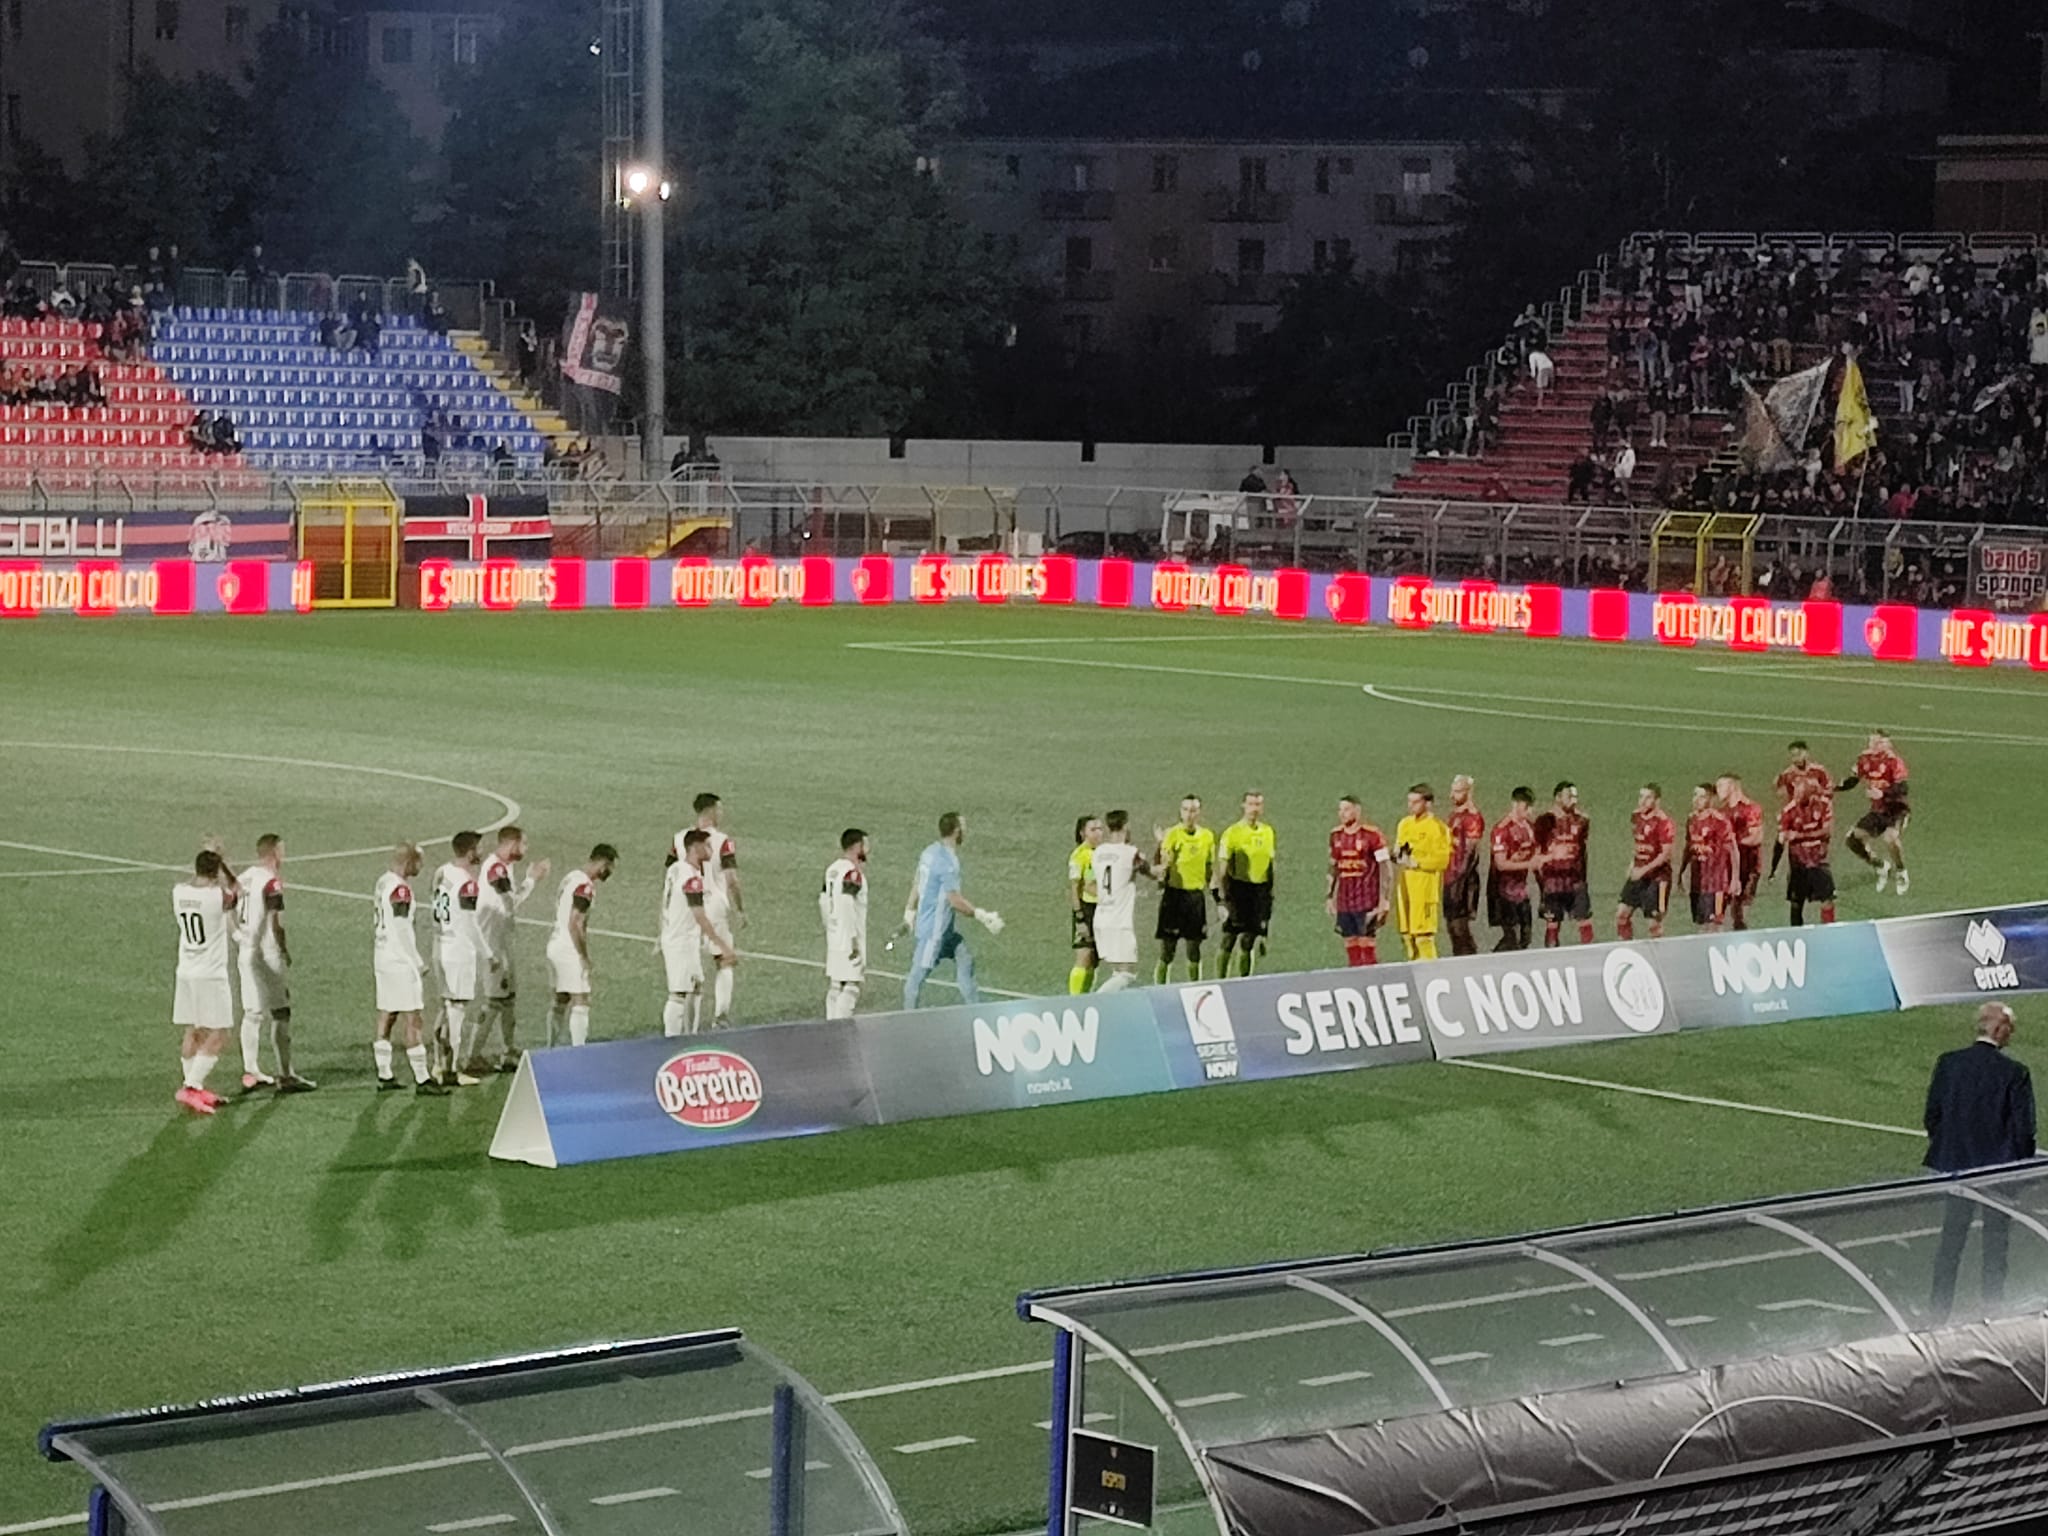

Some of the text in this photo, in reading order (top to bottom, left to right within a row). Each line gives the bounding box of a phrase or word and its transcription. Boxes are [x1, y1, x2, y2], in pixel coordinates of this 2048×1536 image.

[1982, 546, 2040, 572] banda
[0, 570, 158, 608] OTENZA CALCIO
[440, 567, 487, 604] SUNT
[491, 567, 556, 603] LEONES
[672, 565, 806, 600] POTENZA CALCIO
[940, 564, 979, 597] SUNT
[983, 563, 1047, 597] LEONES
[1151, 570, 1279, 611] POTENZA CALCIO
[1388, 584, 1532, 629] HIC SUNT LEONES
[1653, 601, 1807, 646] POTENZA CALCIO
[1940, 618, 1975, 657] HIC
[1980, 620, 2036, 661] SUNT
[1102, 865, 1112, 895] 4
[180, 912, 206, 945] 10
[1708, 938, 1807, 996] NOW
[1277, 983, 1421, 1055] SERIE
[1425, 979, 1465, 1037] C
[1464, 966, 1583, 1035] NOW
[973, 1006, 1099, 1075] NOW
[657, 1065, 761, 1113] Beretta
